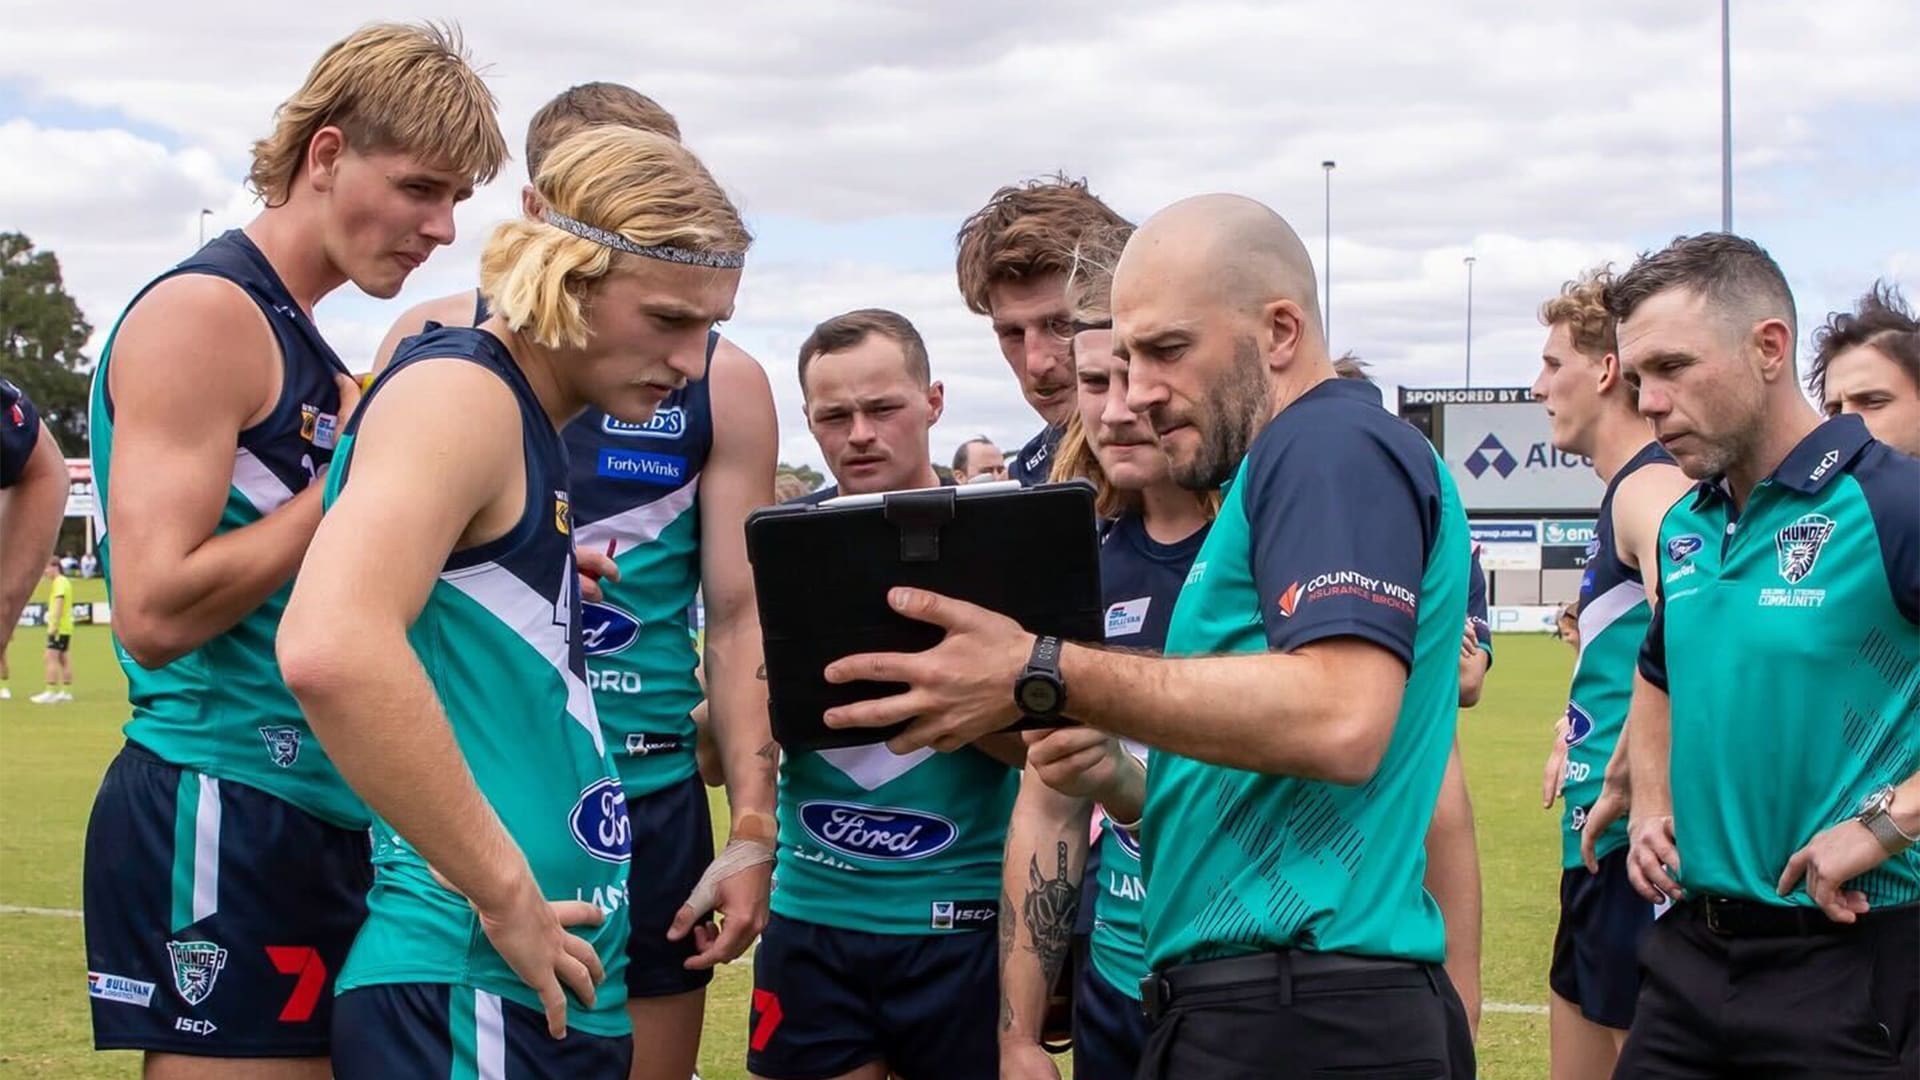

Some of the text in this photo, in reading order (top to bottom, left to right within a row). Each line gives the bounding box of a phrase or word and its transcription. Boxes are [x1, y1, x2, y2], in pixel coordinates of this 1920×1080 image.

[1406, 391, 1495, 403] SPONSORED
[1500, 390, 1519, 402] BY
[1307, 571, 1416, 608] COUNTRY WIDE
[1759, 595, 1825, 607] COMMUNITY
[822, 809, 923, 852] Ford
[106, 978, 150, 998] SULLIVAN
